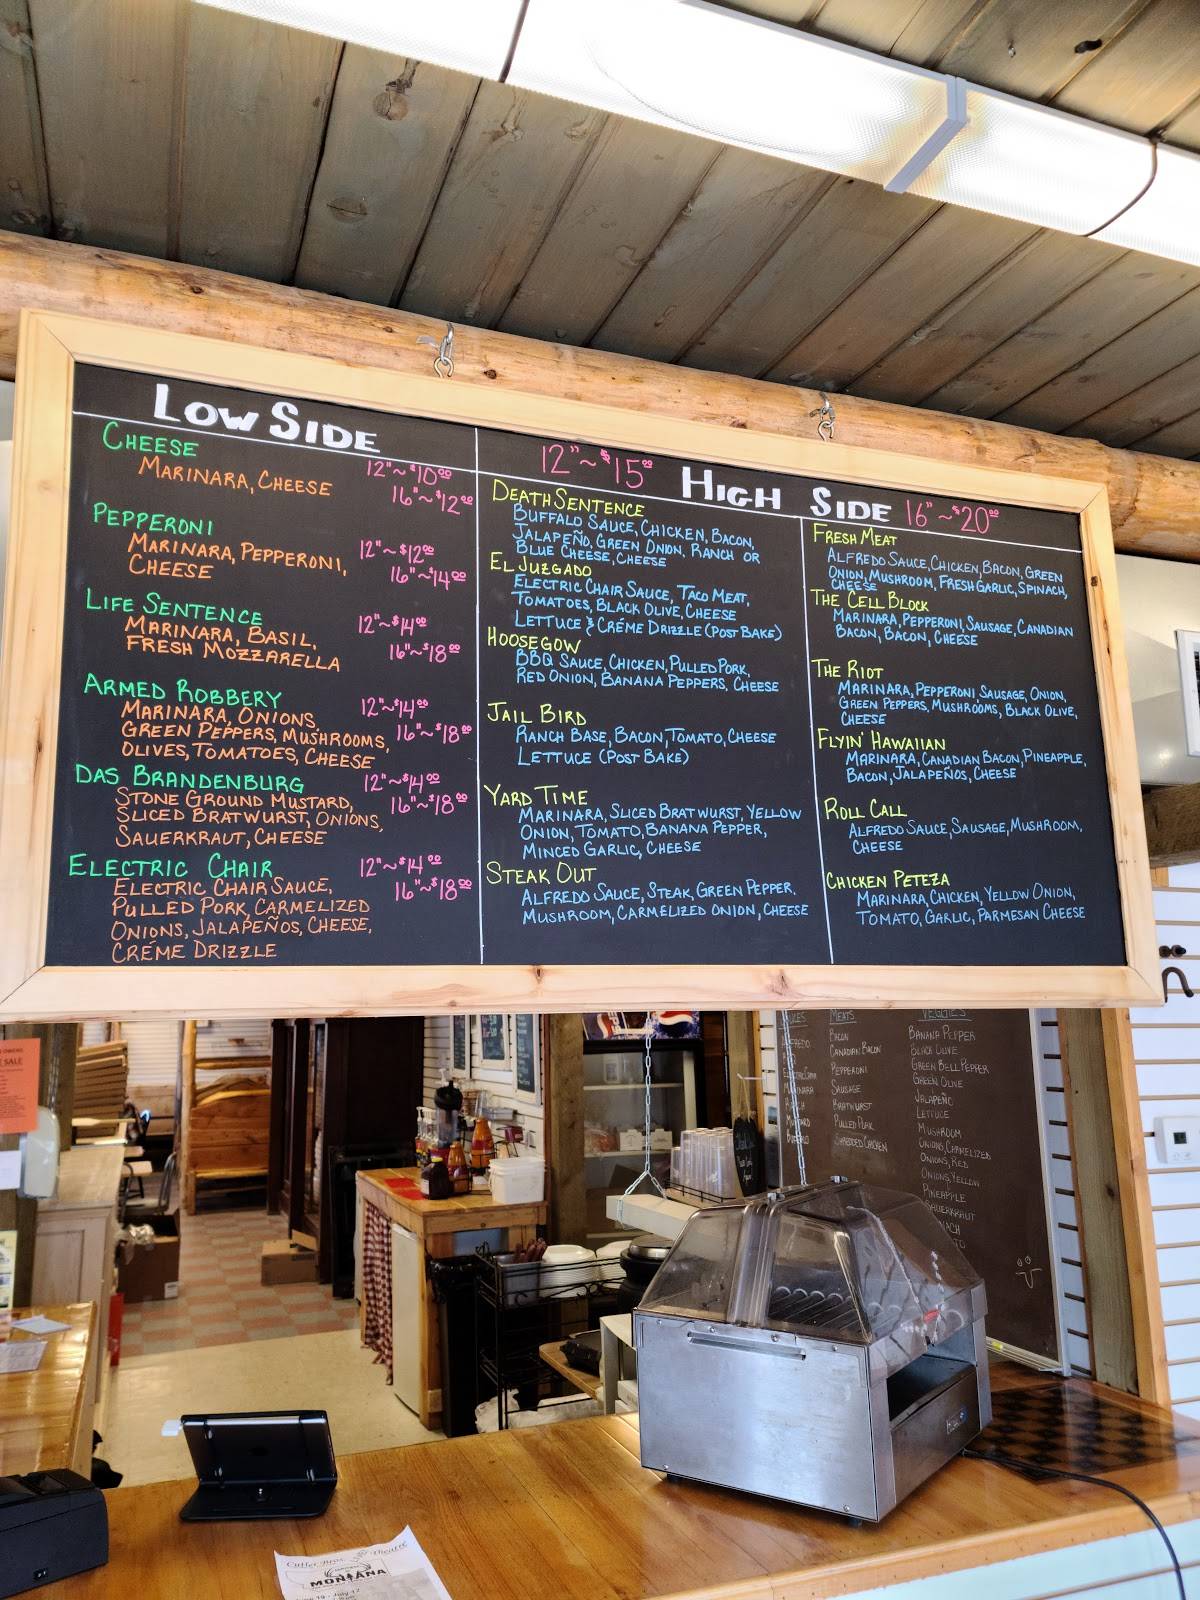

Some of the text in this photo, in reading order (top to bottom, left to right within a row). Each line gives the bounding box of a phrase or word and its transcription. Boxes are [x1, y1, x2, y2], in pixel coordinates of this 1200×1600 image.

[101, 420, 200, 456] CHEESE
[258, 470, 332, 496] CHEESE
[493, 478, 645, 519] DEATH SENTENCE
[94, 502, 212, 535] PEPPERONI
[514, 502, 582, 527] BUFFALO
[814, 523, 898, 546] FRESH MEAT
[491, 552, 591, 576] EL JUZGADO
[828, 547, 886, 566] ALFREDO
[1025, 566, 1063, 582] GREEN
[513, 574, 582, 594] ELECTRIC
[586, 578, 623, 598] CHAIR
[677, 585, 708, 602] TACO
[87, 588, 262, 625] LIFE SENTENCE
[810, 589, 929, 612] THE CELL BLOCK
[934, 630, 978, 646] CHEESE
[1017, 619, 1073, 637] CANADIAN
[488, 626, 581, 655] HOOSEGOW
[127, 635, 340, 672] FRESH MOZZARELLA
[811, 659, 884, 679] THE RIOT
[84, 673, 282, 709] ARMED ROBBERY
[488, 702, 586, 725] JAIL BIRD
[122, 722, 191, 738] GREEN
[516, 724, 564, 743] RANCH
[728, 728, 777, 743] CHEESE
[818, 728, 945, 750] FLYIN' HAWAIIAN
[518, 746, 591, 766] LETTUCE
[644, 748, 689, 765] BAKE)
[922, 752, 980, 766] CANADIAN
[76, 764, 304, 794] DAS BRANDENBURG
[974, 766, 1016, 780] CHEESE
[115, 786, 179, 808] STONE
[186, 790, 263, 808] GROUND
[484, 784, 588, 806] YARD TIME
[117, 805, 184, 823] SLICED
[824, 797, 907, 820] ROLL CALL
[254, 828, 327, 845] CHEESE
[523, 843, 579, 860] MINCED
[646, 841, 701, 854] CHEESE
[69, 853, 272, 879] ELECTRIC CHAIR
[487, 861, 597, 884] STEAK OUT
[114, 878, 202, 896] ELECTRIC
[210, 878, 267, 896] CHAIR
[826, 870, 950, 889] CHICKEN PETEZA
[522, 889, 590, 906] ALFREDO
[696, 882, 743, 898] GREEN
[984, 886, 1029, 901] YELLOW
[112, 898, 194, 917] PULLED
[255, 899, 369, 915] CARMELIZED
[977, 908, 1039, 922] PARMESAN
[1043, 904, 1085, 920] CHEESE
[194, 940, 276, 959] DRIZZLE
[310, 1569, 387, 1587] MONTANA
